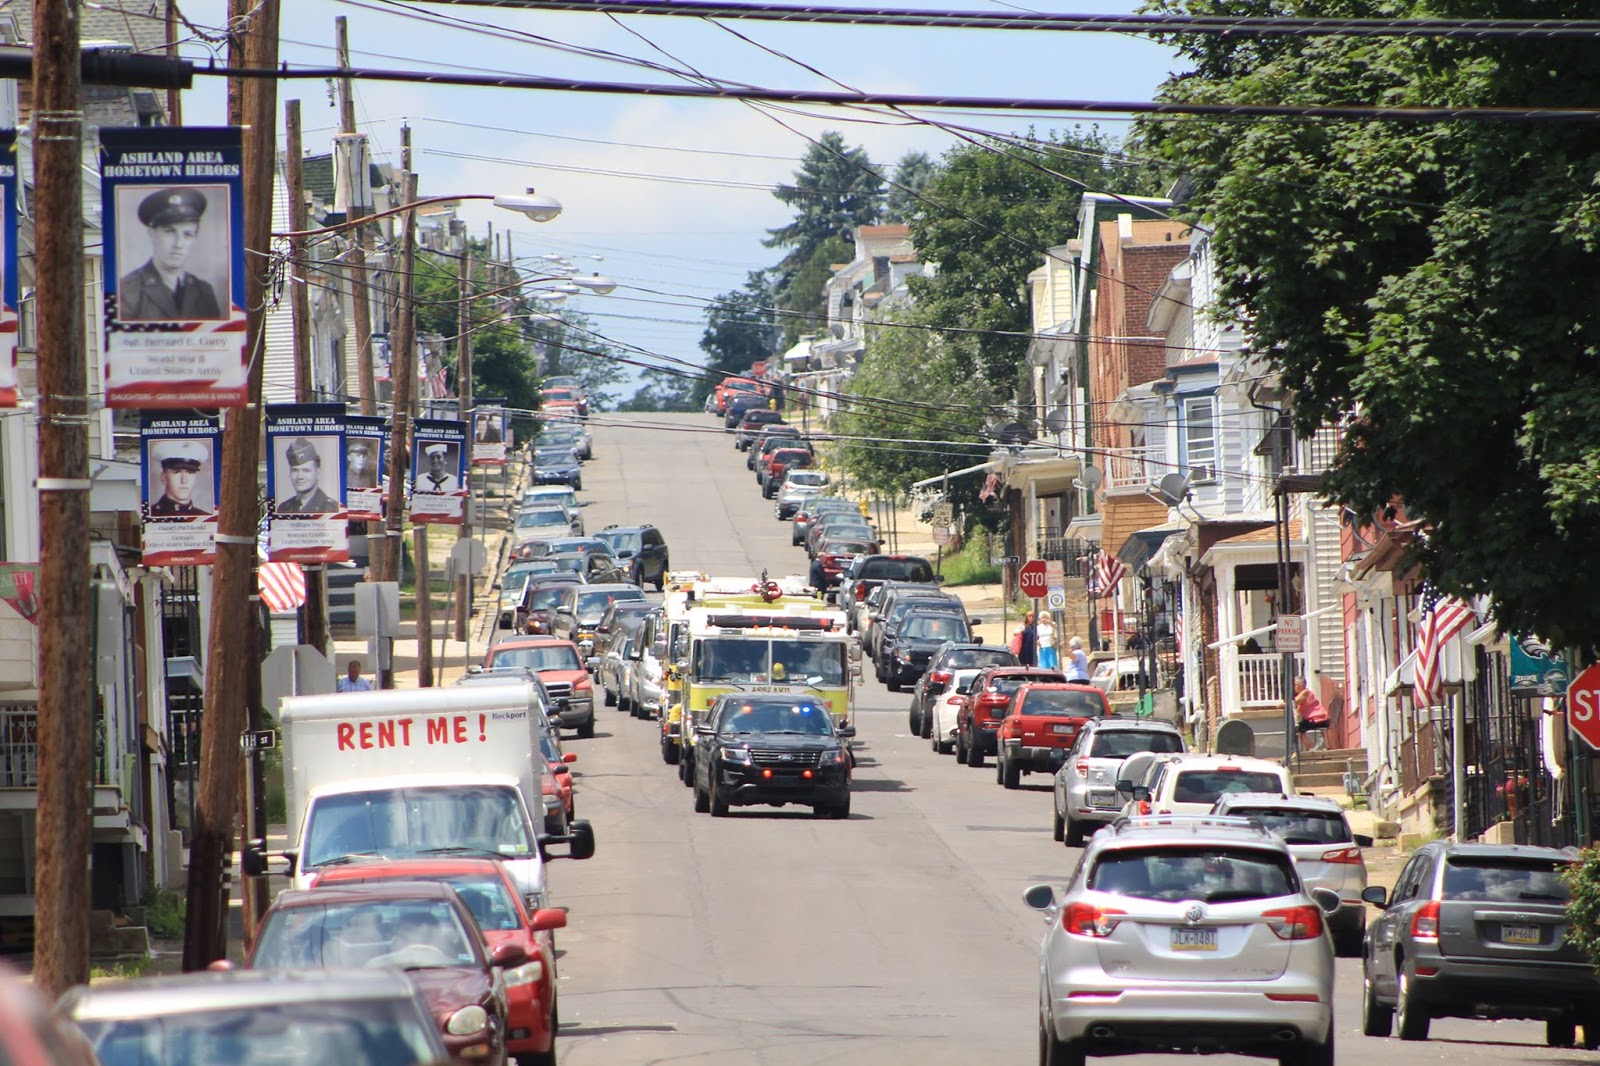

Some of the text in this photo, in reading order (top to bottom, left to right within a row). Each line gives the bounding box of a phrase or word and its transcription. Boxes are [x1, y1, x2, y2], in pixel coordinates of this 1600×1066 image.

[120, 152, 224, 164] ASHLAND AREA
[104, 164, 240, 177] HOMETOWN HEROES
[150, 419, 209, 428] ASHLAND AREA
[936, 516, 950, 526] 25
[1284, 619, 1294, 627] NO
[491, 711, 527, 720] Rockport
[337, 718, 413, 751] RENT
[260, 736, 268, 744] ST
